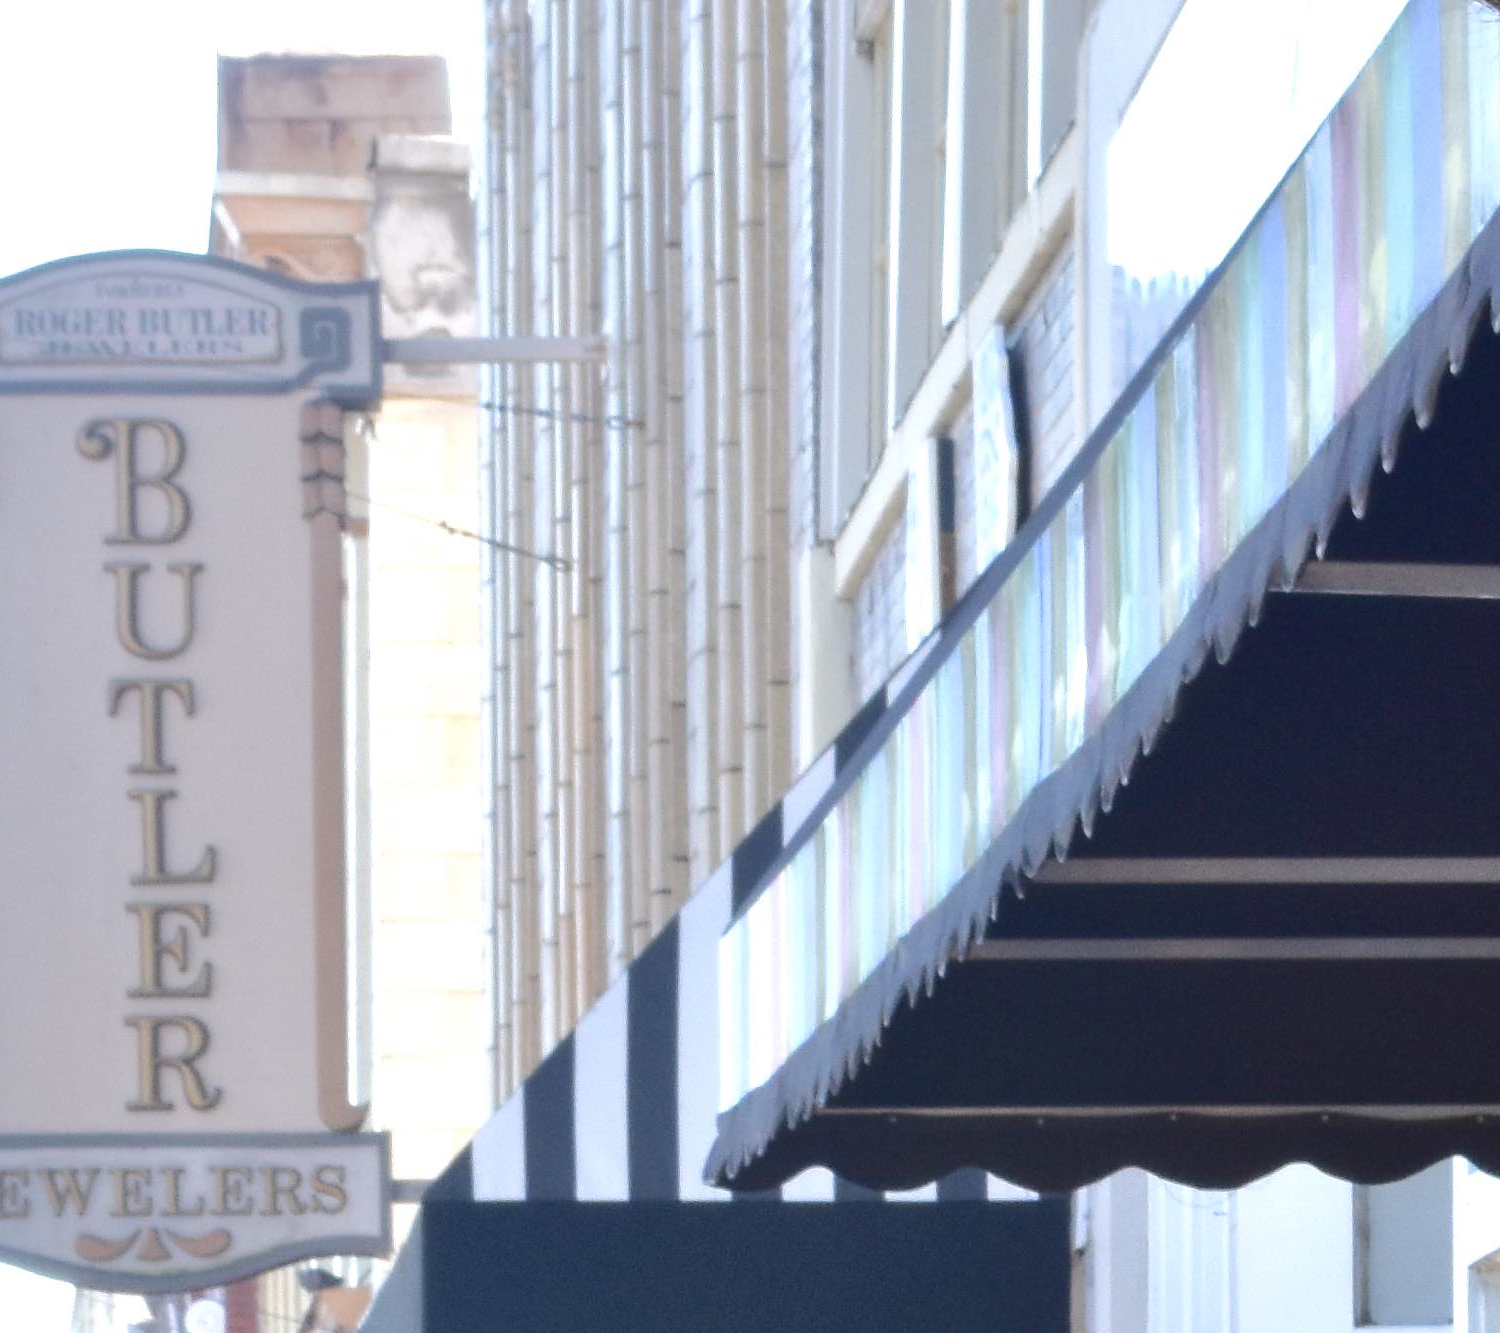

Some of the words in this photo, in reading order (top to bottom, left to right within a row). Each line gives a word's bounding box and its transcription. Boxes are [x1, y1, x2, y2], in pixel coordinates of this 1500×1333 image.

[13, 309, 126, 336] ROGER
[136, 308, 268, 336] BUTLER
[75, 416, 223, 1114] BUTLER
